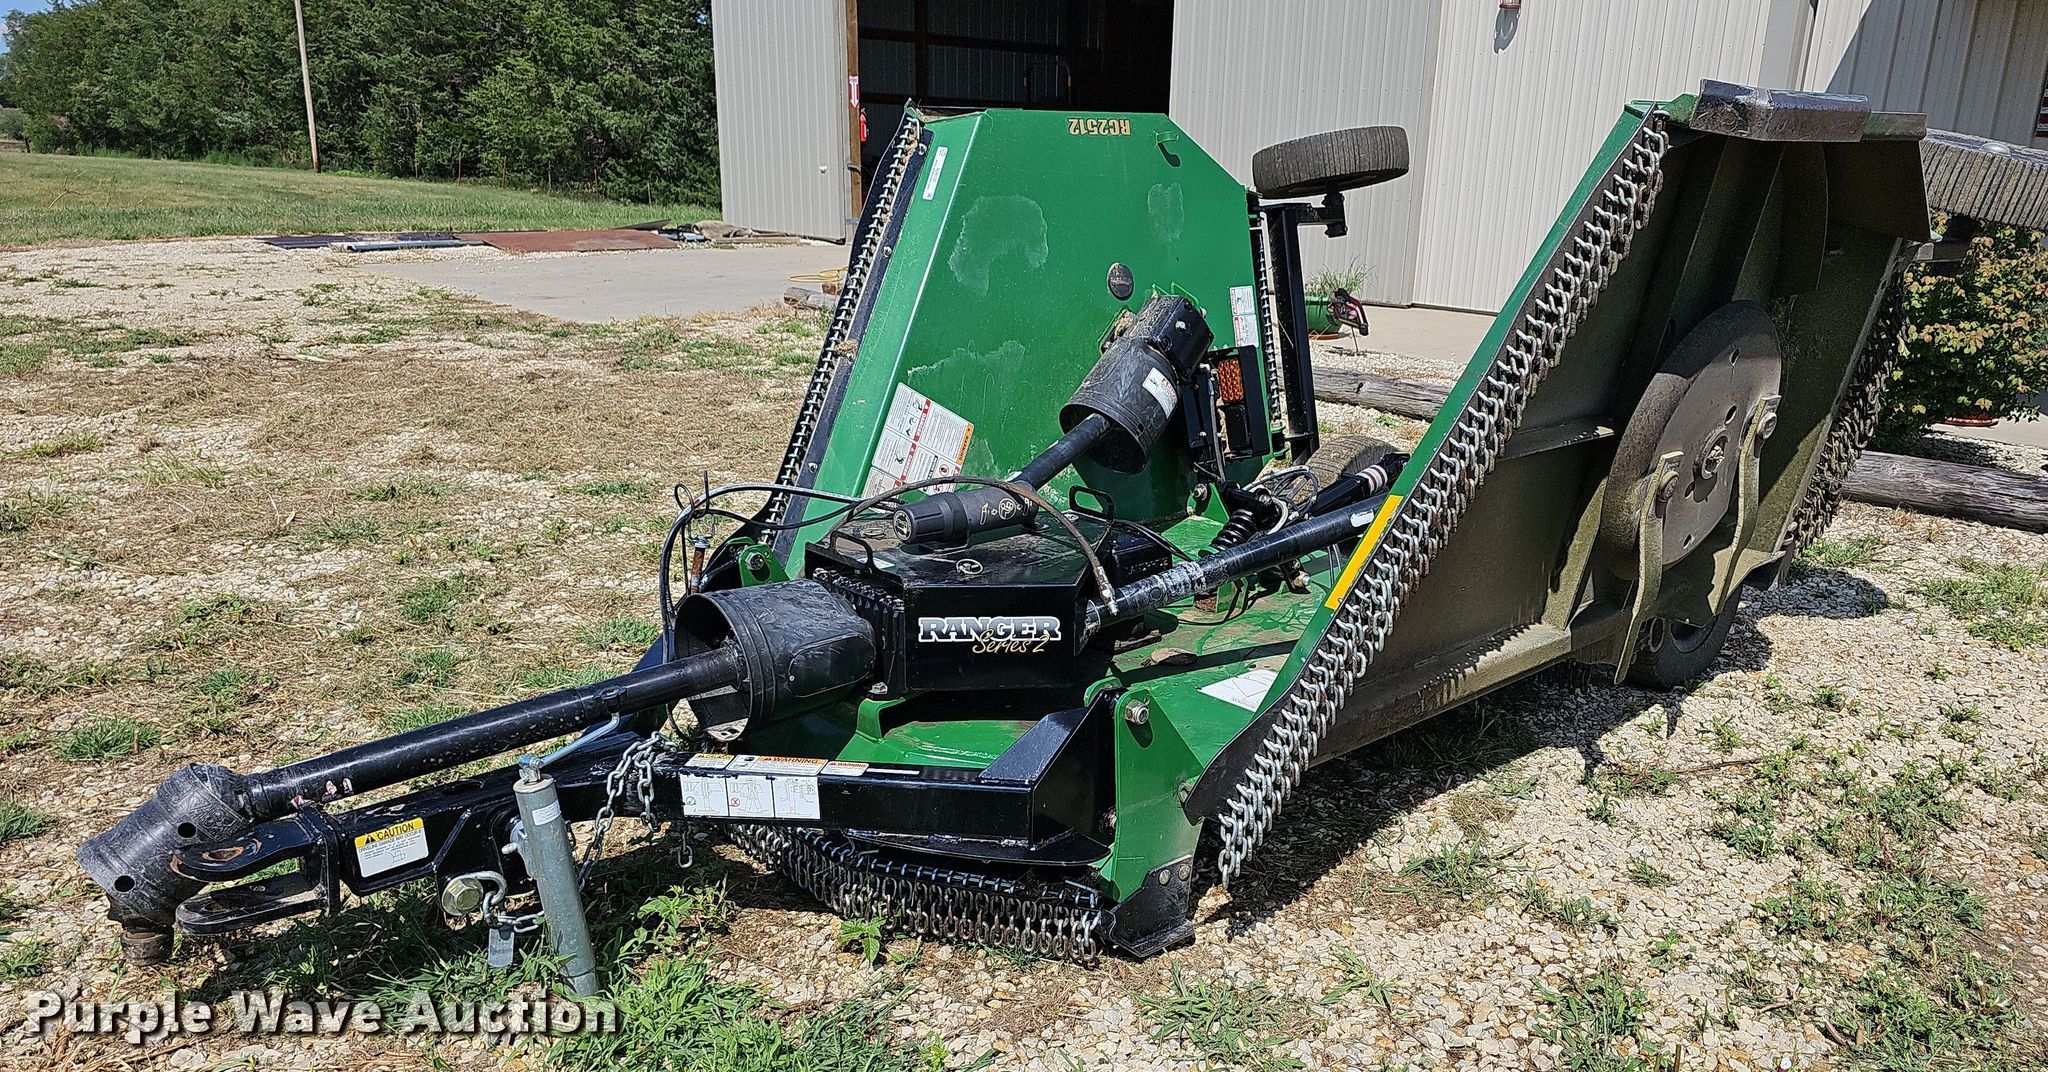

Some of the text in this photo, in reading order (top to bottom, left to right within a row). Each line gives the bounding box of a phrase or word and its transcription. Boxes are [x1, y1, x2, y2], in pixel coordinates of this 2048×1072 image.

[1067, 118, 1131, 136] RC2512
[918, 617, 1061, 642] RANGER
[972, 628, 1050, 653] Series 2
[377, 822, 414, 840] CAUTION
